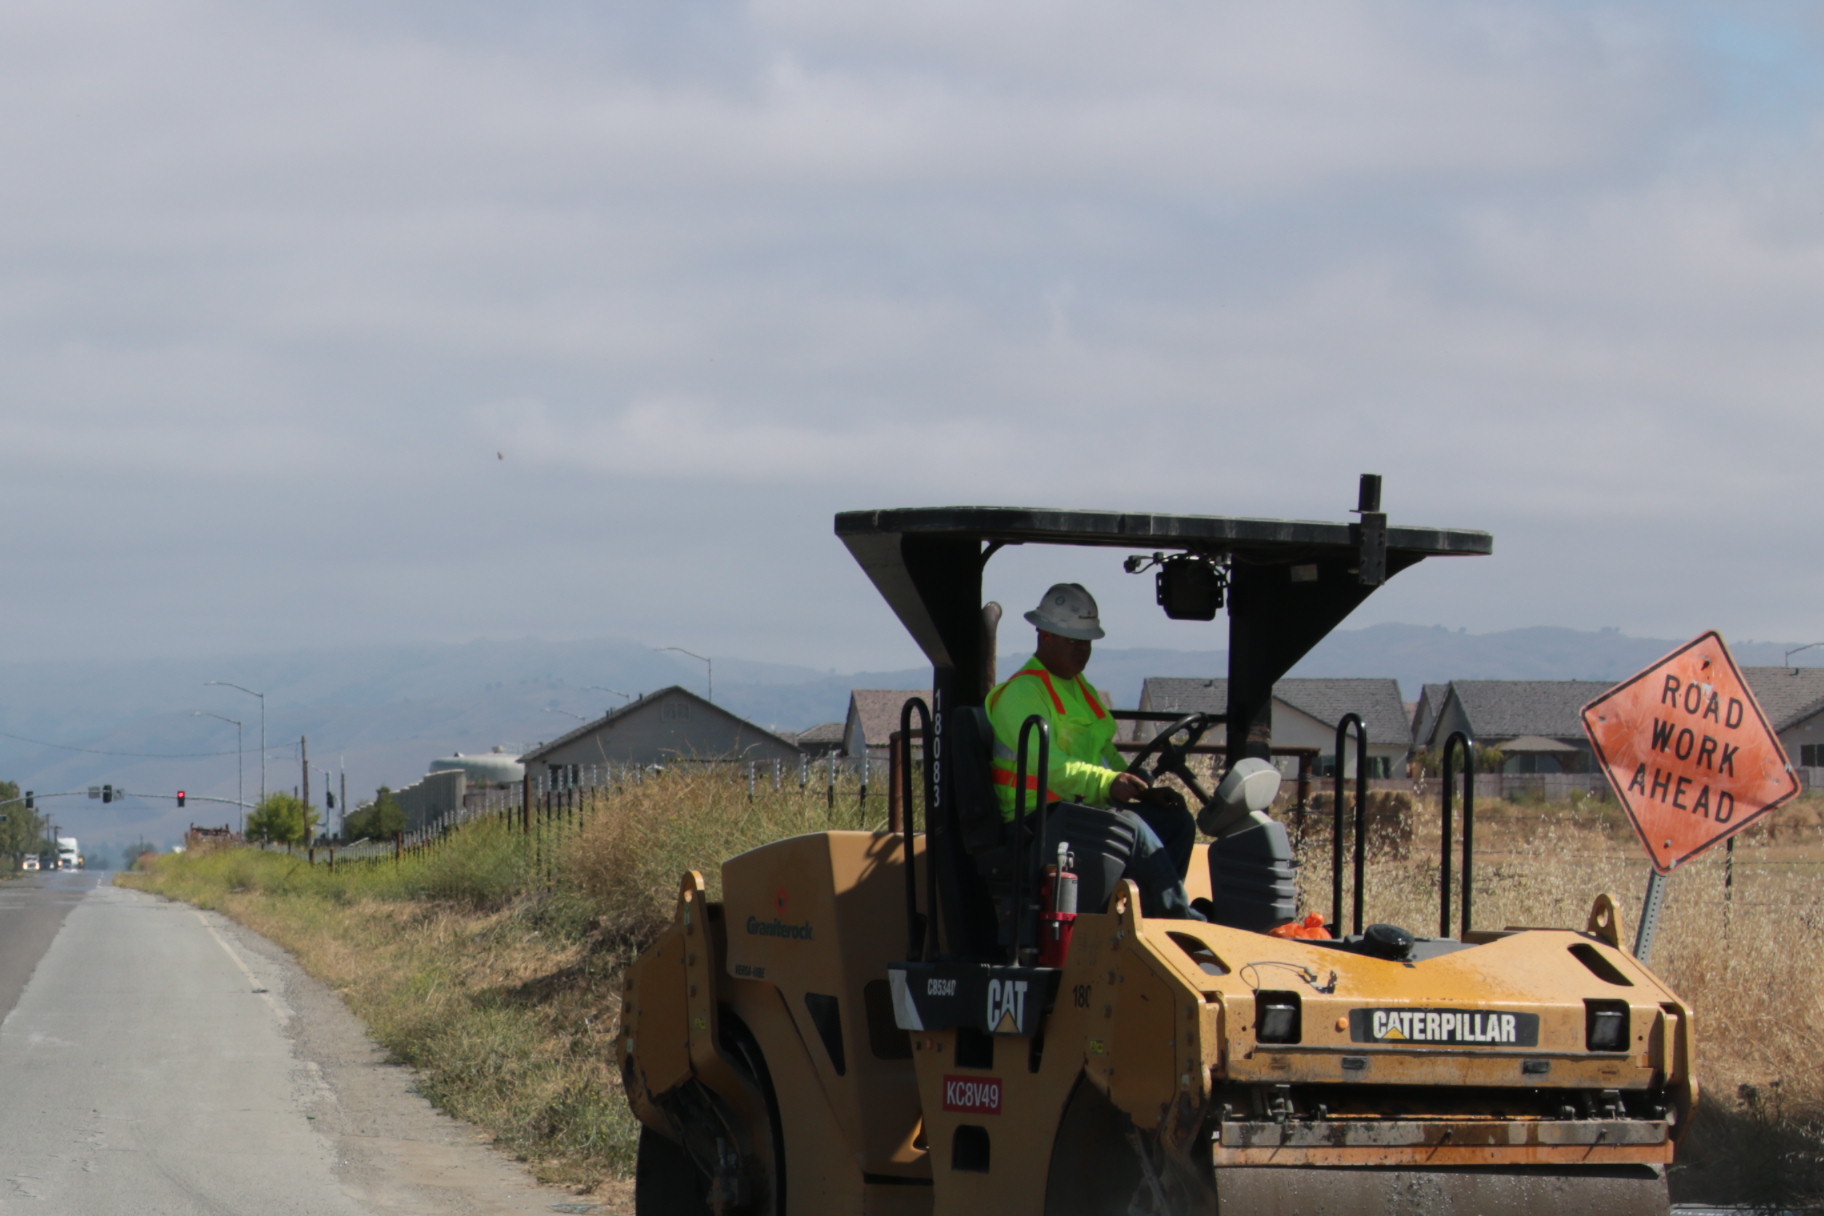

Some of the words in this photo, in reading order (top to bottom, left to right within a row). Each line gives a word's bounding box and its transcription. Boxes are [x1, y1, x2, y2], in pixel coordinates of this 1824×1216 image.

[1661, 674, 1744, 729] ROAD
[933, 688, 942, 808] 18083
[1651, 717, 1740, 778] WORK
[1627, 762, 1735, 824] AHEAD
[746, 915, 814, 940] Graniterock
[987, 978, 1028, 1034] CAT
[1372, 1009, 1516, 1043] CATERPILLAR
[946, 1080, 999, 1109] KC8V49
